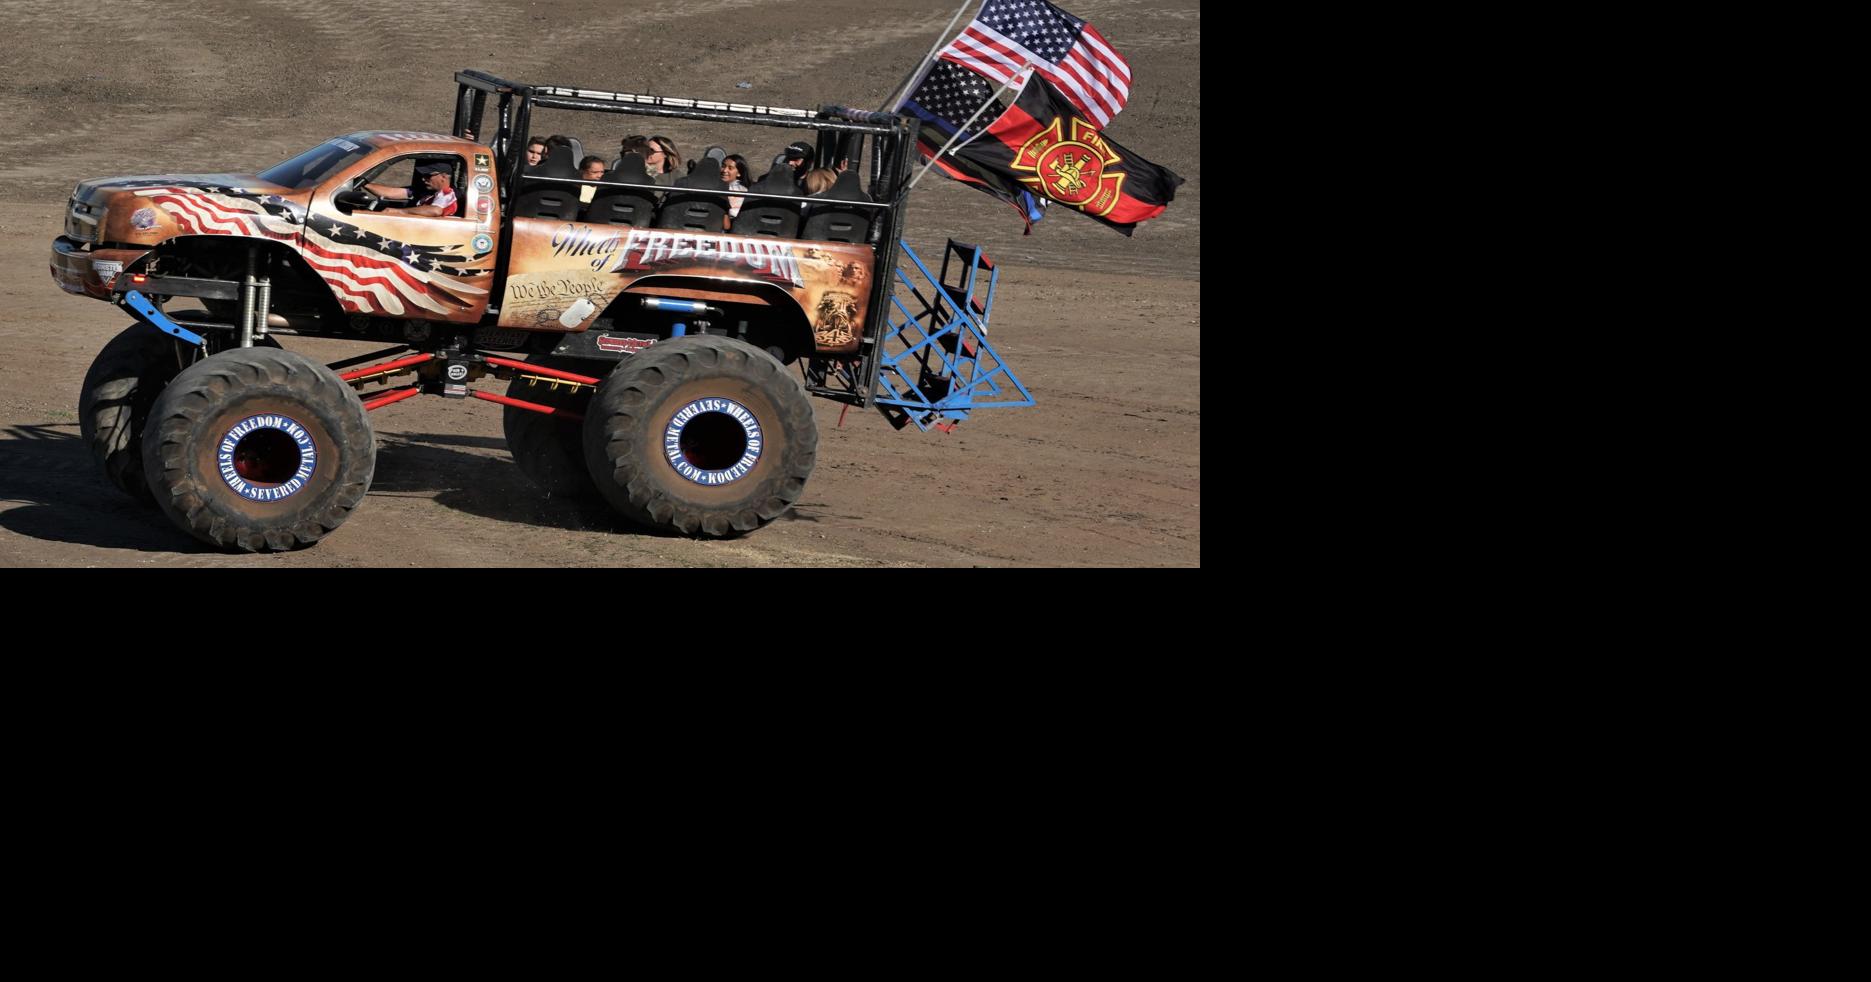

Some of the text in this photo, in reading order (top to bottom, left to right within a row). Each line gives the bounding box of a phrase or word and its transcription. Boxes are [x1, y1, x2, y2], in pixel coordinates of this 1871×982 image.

[1082, 131, 1105, 153] FIR
[552, 223, 620, 257] Wheels
[590, 228, 805, 288] of FREEDOM
[510, 277, 604, 299] We the People
[672, 400, 721, 427] SEVERED
[219, 416, 283, 493] WHEELS OF FREEDOM
[708, 402, 760, 484] WHEELS OF FREEDOM
[249, 478, 302, 500] SEVERED
